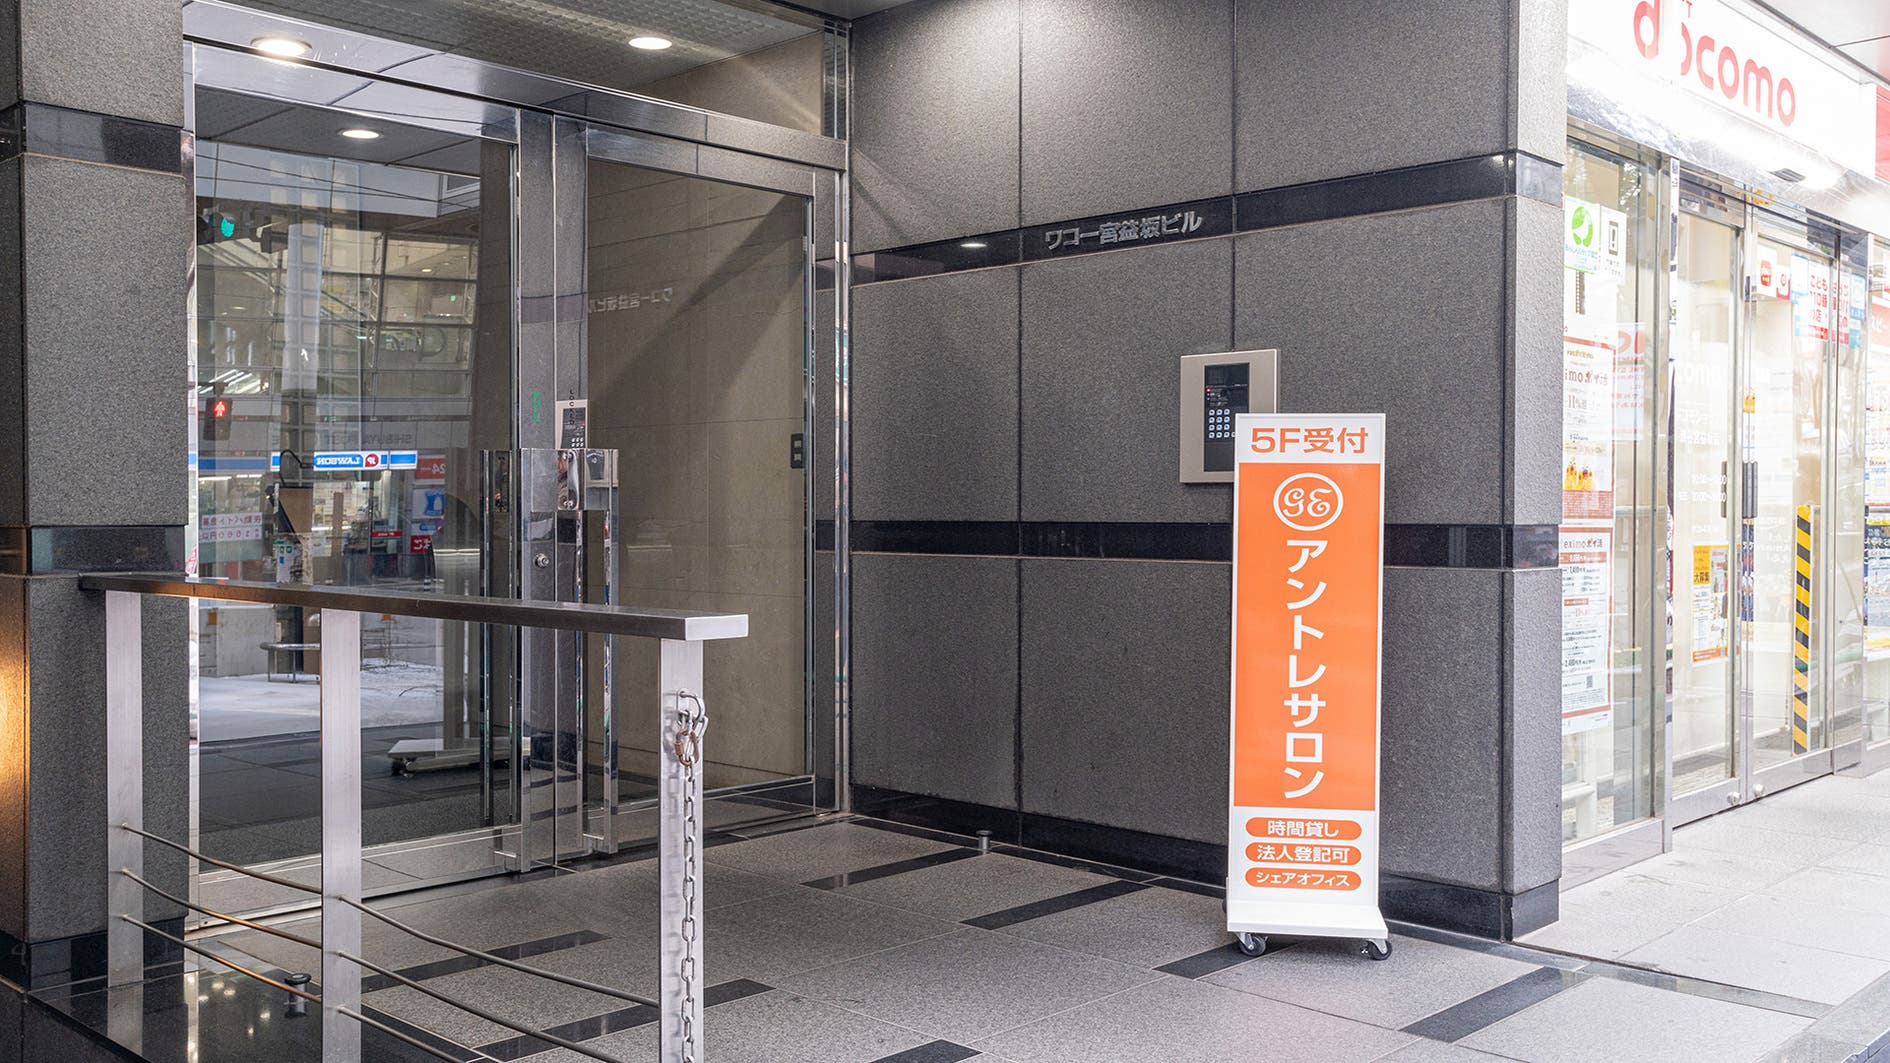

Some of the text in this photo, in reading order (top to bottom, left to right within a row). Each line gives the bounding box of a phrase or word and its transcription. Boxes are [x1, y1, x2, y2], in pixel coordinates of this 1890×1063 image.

[1045, 210, 1203, 251] ワコー宮益坂ビル
[1250, 427, 1369, 454] 5F受付
[1283, 540, 1328, 799] アントレサロン
[1267, 820, 1339, 838] 時間貸し
[1256, 844, 1351, 864] 法人登記可
[1255, 871, 1351, 888] シェアオフィス
